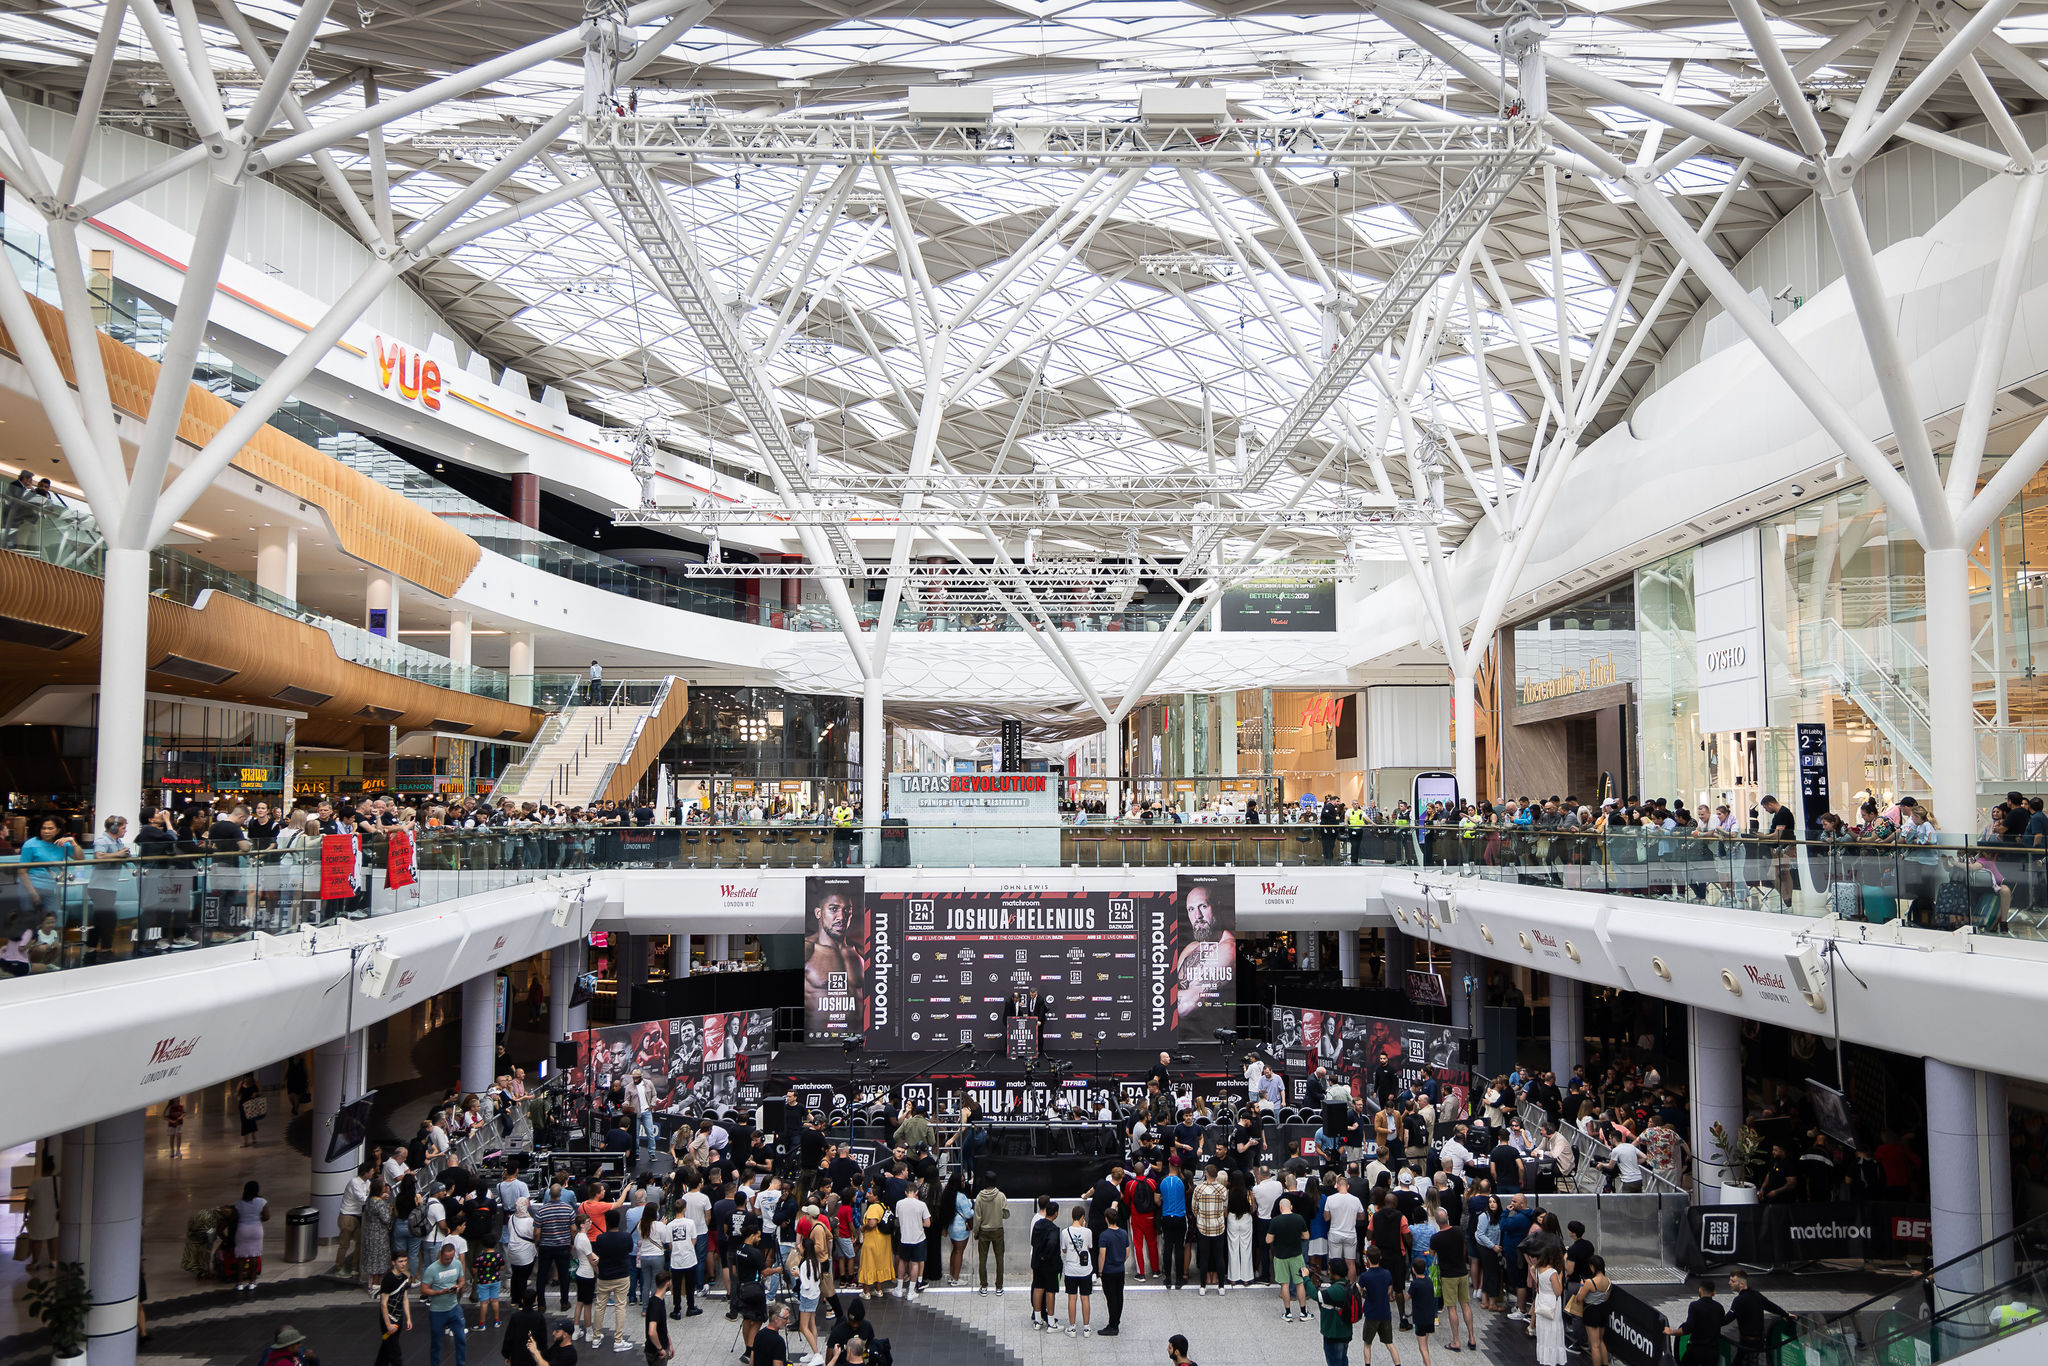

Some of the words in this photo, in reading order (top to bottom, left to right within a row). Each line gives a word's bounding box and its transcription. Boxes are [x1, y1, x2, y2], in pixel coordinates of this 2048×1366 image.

[1706, 645, 1746, 672] OYSHO
[1523, 664, 1576, 704] Abercrombie
[1578, 668, 1587, 690] &
[1590, 650, 1616, 688] Fitch
[1301, 698, 1344, 727] H&M
[1801, 736, 1810, 748] 2
[620, 830, 656, 843] Westfield
[720, 884, 759, 898] Westfield
[1261, 882, 1298, 895] Westfield
[947, 908, 1009, 929] JOSHUA
[1017, 908, 1095, 929] HELENIUS
[1532, 930, 1557, 947] Westfield
[875, 913, 892, 1030] matchroom.
[1152, 912, 1169, 1031] matchroom.
[1186, 967, 1232, 981] HELENIUS
[1744, 965, 1786, 989] Westfield
[1759, 991, 1779, 1001] LONDON
[818, 997, 855, 1011] JOSHUA
[147, 1036, 202, 1067] Westfield
[707, 1063, 717, 1072] 12TH
[750, 1064, 767, 1072] JOSHUA
[140, 1069, 168, 1085] LONDON
[909, 1088, 925, 1098] DA
[1127, 1087, 1143, 1097] DA
[1710, 1222, 1729, 1233] 258
[1709, 1234, 1728, 1246] MGT
